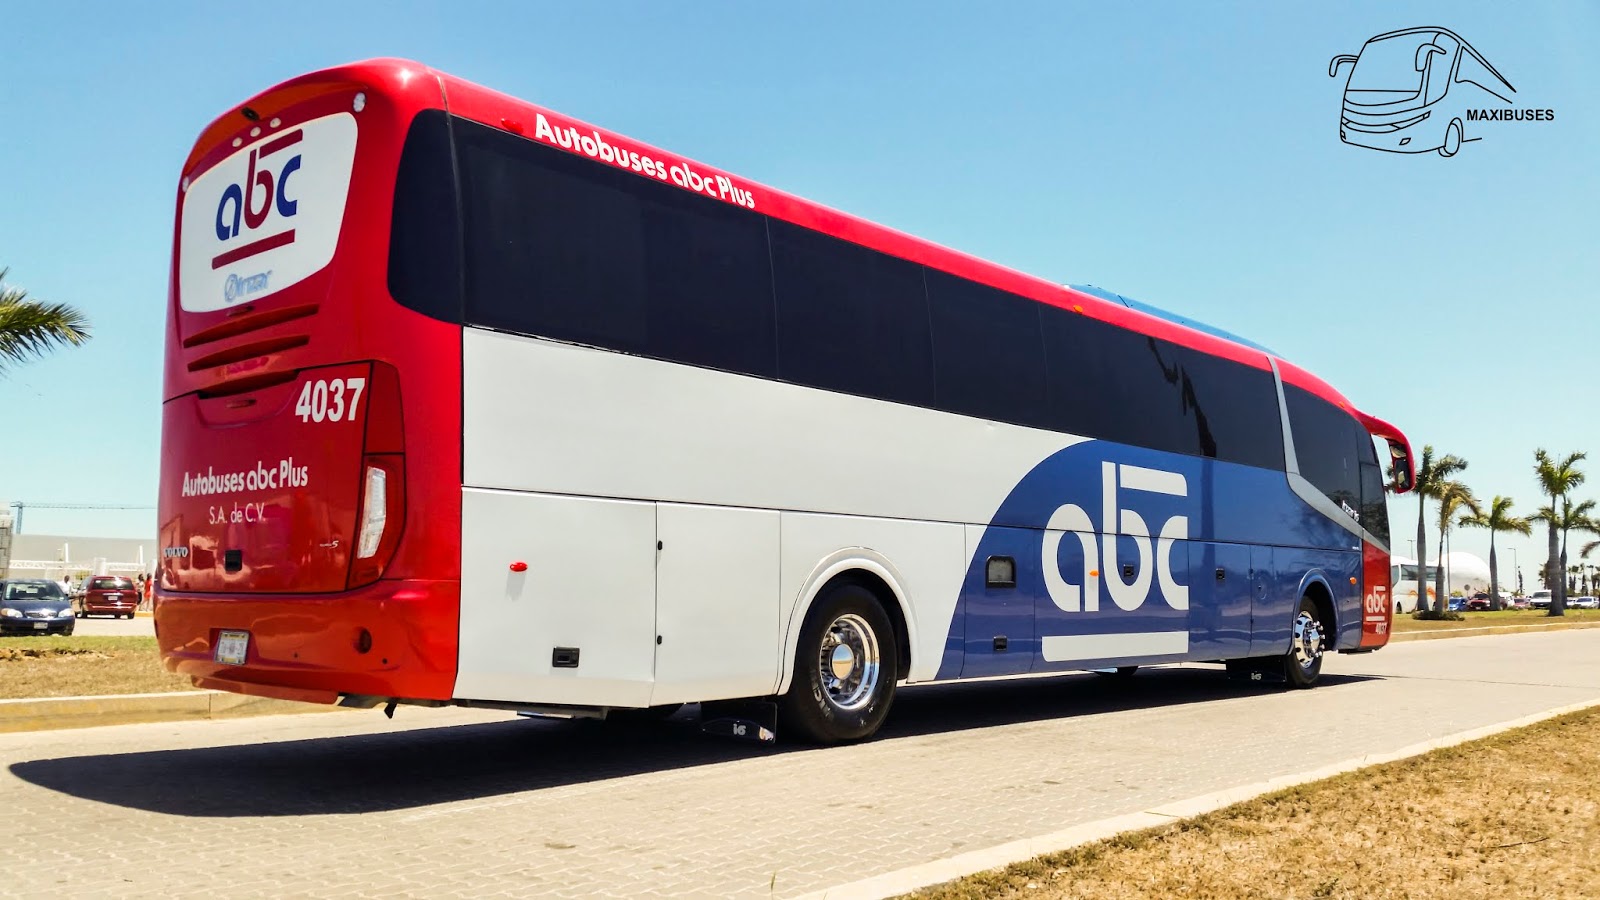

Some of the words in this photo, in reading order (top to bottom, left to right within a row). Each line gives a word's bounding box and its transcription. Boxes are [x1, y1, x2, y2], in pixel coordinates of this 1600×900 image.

[535, 113, 668, 181] Autobuses
[669, 162, 717, 197] abc
[715, 174, 755, 209] Plus
[215, 147, 302, 242] abc
[295, 377, 366, 423] 4037
[181, 466, 245, 497] Autobuses
[246, 460, 278, 491] abc
[279, 456, 309, 488] Plus
[208, 505, 228, 525] S.A.
[230, 501, 243, 523] de
[1041, 460, 1190, 613] abc
[1366, 585, 1386, 614] abc
[732, 723, 747, 736] i6
